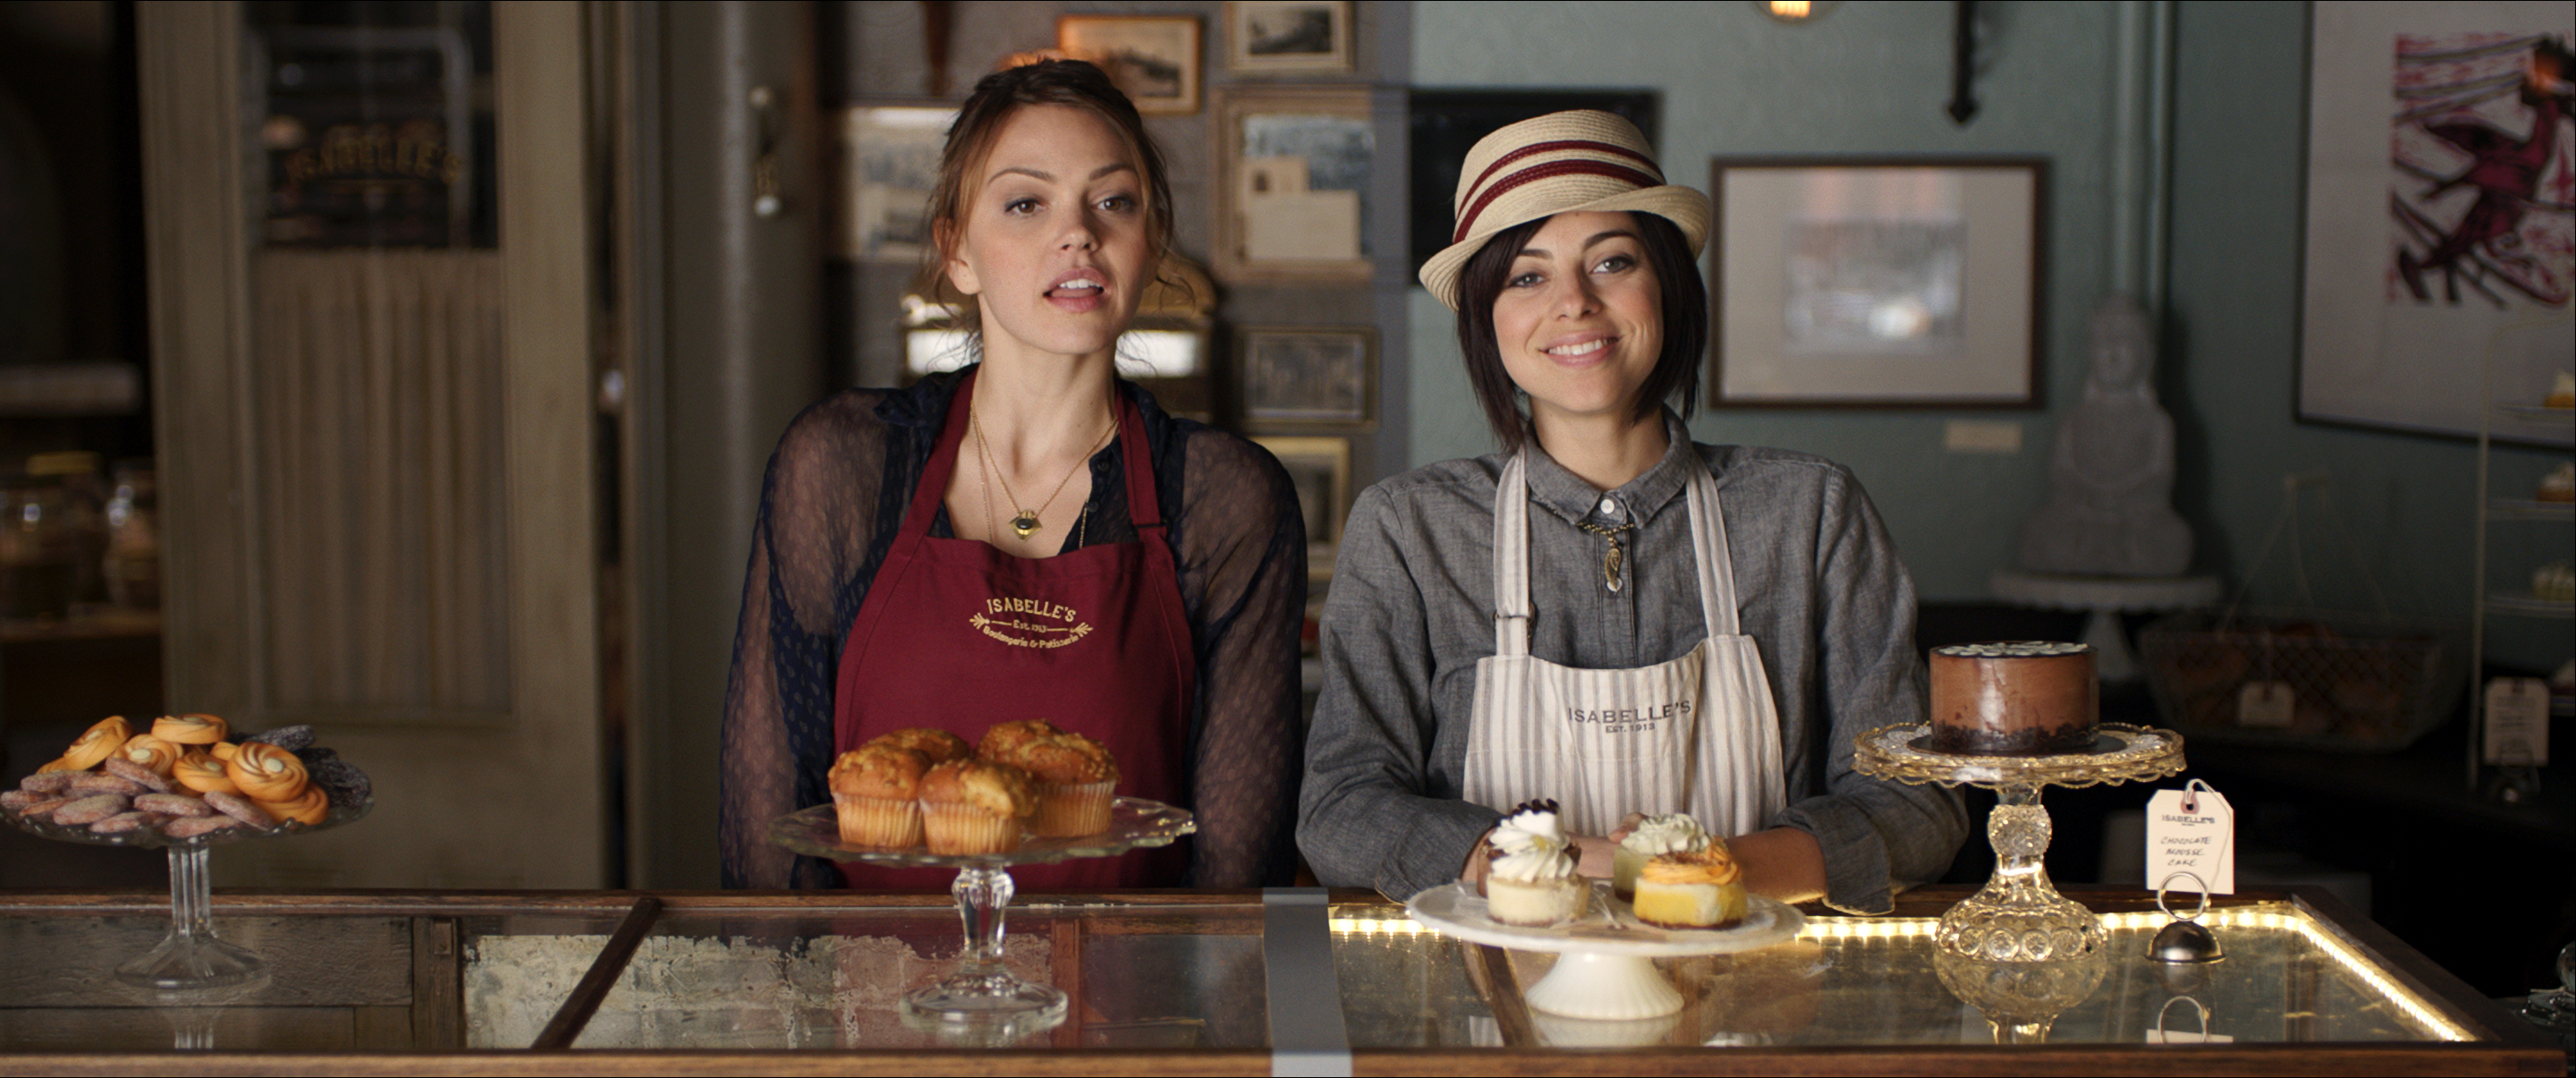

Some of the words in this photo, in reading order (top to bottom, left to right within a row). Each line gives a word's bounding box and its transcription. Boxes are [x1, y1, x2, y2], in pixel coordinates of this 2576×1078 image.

[987, 597, 1076, 622] ISABELLE'S
[1030, 640, 1038, 648] &
[1568, 700, 1691, 724] ISABELLE'S
[1630, 722, 1656, 732] 1913
[2161, 836, 2212, 845] CHOCOLATE
[2167, 859, 2197, 867] CAKE
